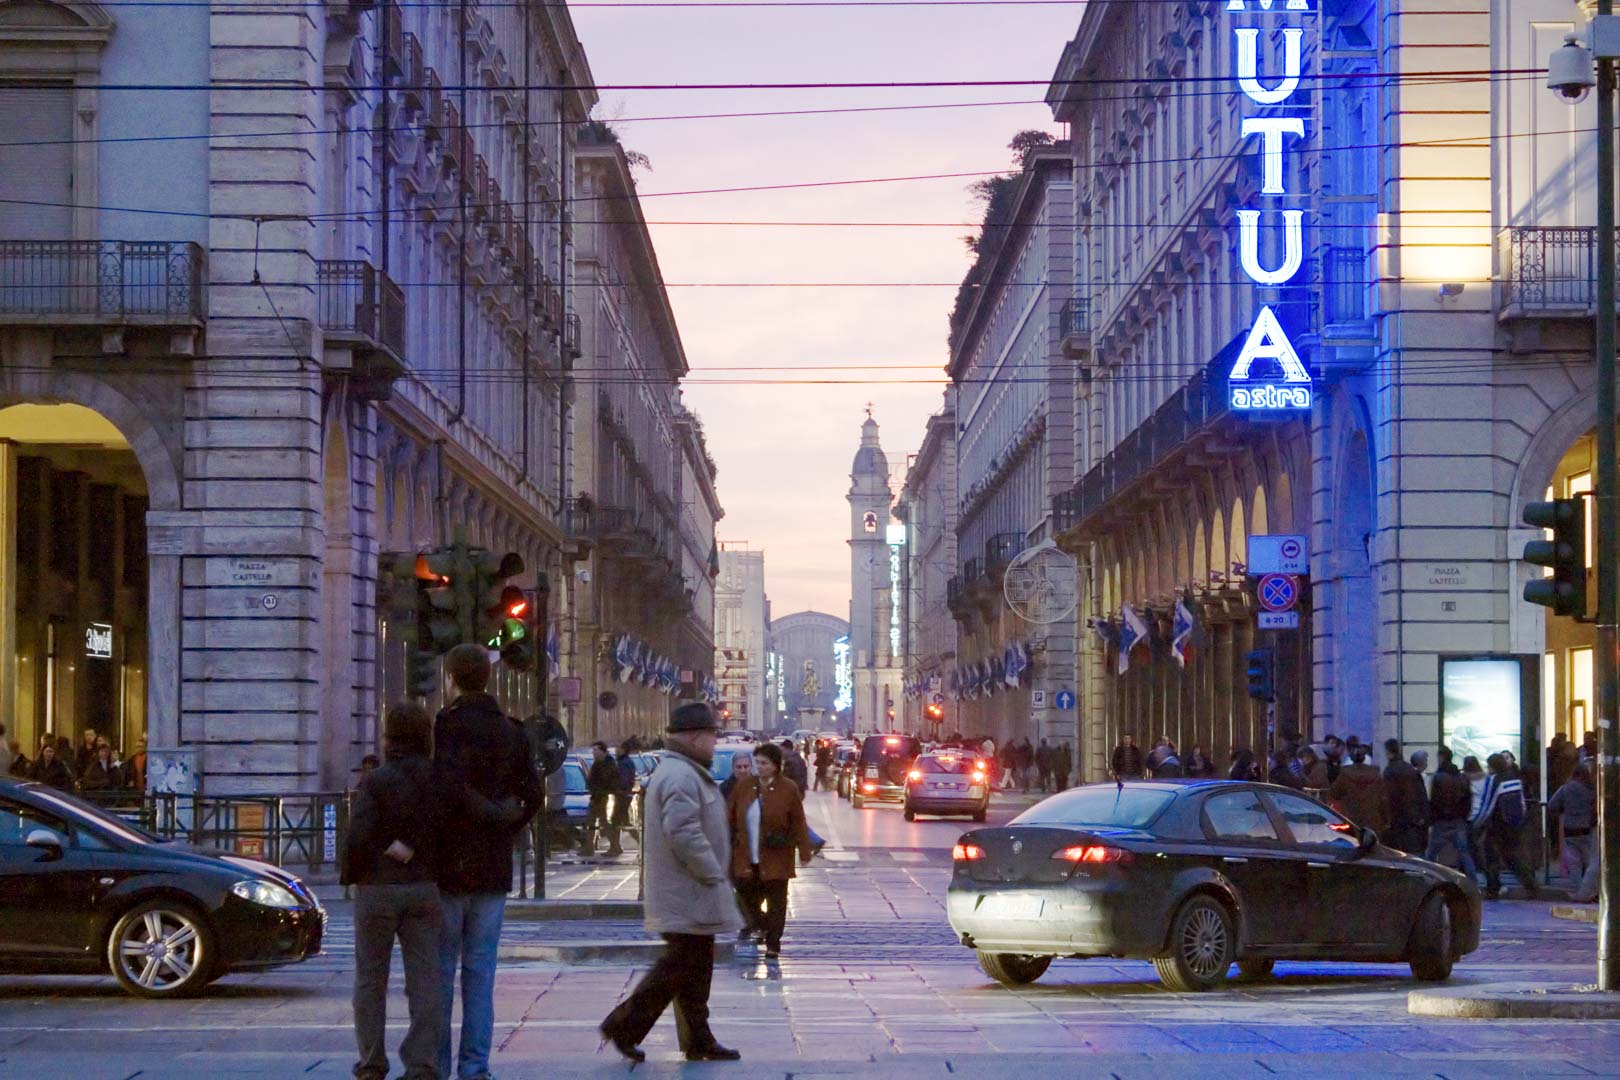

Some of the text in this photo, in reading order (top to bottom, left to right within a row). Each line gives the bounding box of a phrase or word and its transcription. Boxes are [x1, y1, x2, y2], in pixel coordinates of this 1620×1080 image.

[1227, 0, 1311, 382] UTUA
[1232, 385, 1310, 408] astra
[239, 563, 267, 571] PIAZZA
[232, 573, 273, 581] CASTELLO
